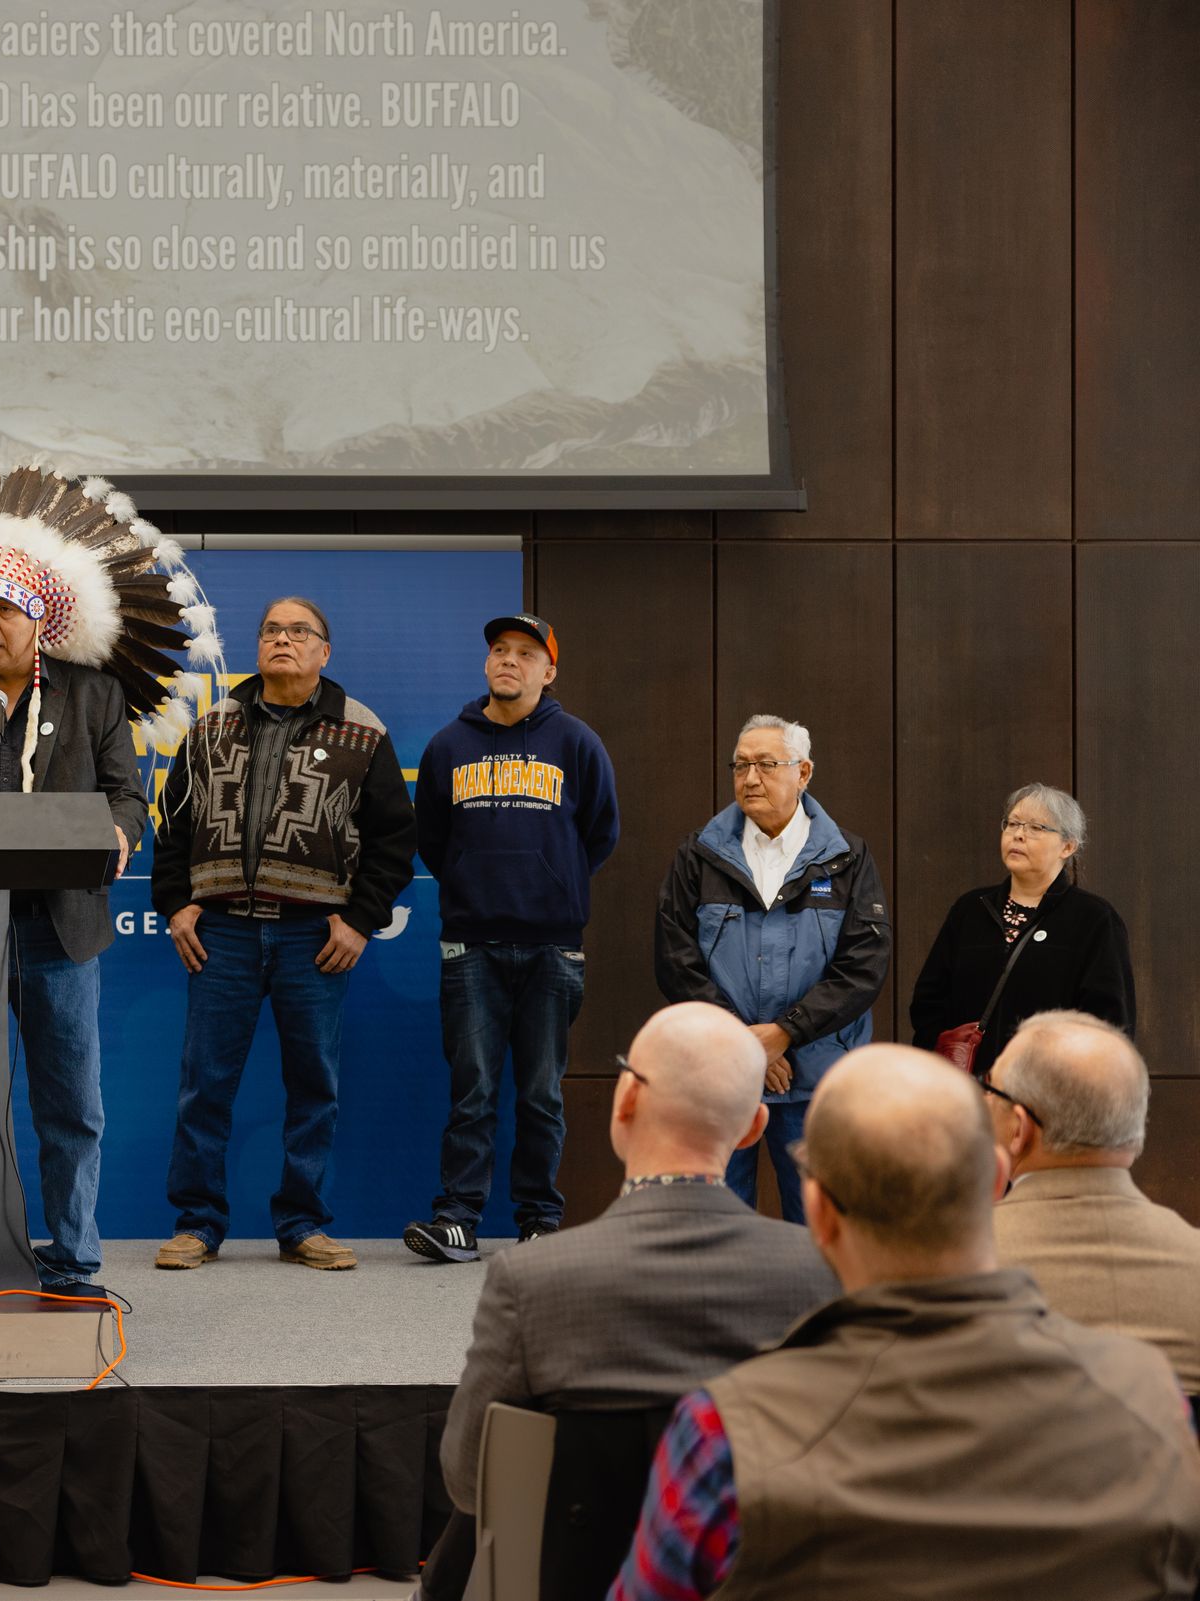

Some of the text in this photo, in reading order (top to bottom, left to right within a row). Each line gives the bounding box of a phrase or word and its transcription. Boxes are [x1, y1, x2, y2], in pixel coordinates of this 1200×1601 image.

[110, 11, 177, 56] that
[188, 11, 313, 56] covered
[325, 11, 414, 56] North
[425, 10, 567, 56] America.
[22, 82, 77, 128] has
[88, 82, 163, 128] been
[175, 93, 228, 128] our
[238, 82, 370, 128] relative.
[382, 82, 519, 128] BUFFALO
[128, 153, 293, 210] culturally,
[304, 153, 477, 210] materially,
[488, 153, 545, 199] and
[68, 224, 95, 271] is
[105, 236, 141, 270] so
[152, 225, 236, 270] close
[247, 225, 304, 270] and
[315, 236, 351, 270] so
[362, 225, 517, 270] embodied
[529, 225, 557, 270] in
[570, 235, 606, 270] us
[34, 296, 154, 342] holistic
[165, 296, 360, 342] eco-cultural
[373, 296, 529, 353] life-ways.
[482, 753, 522, 762] FACULTY
[452, 760, 564, 806] MANAGEMENT
[512, 800, 553, 811] LETHBRIDGE
